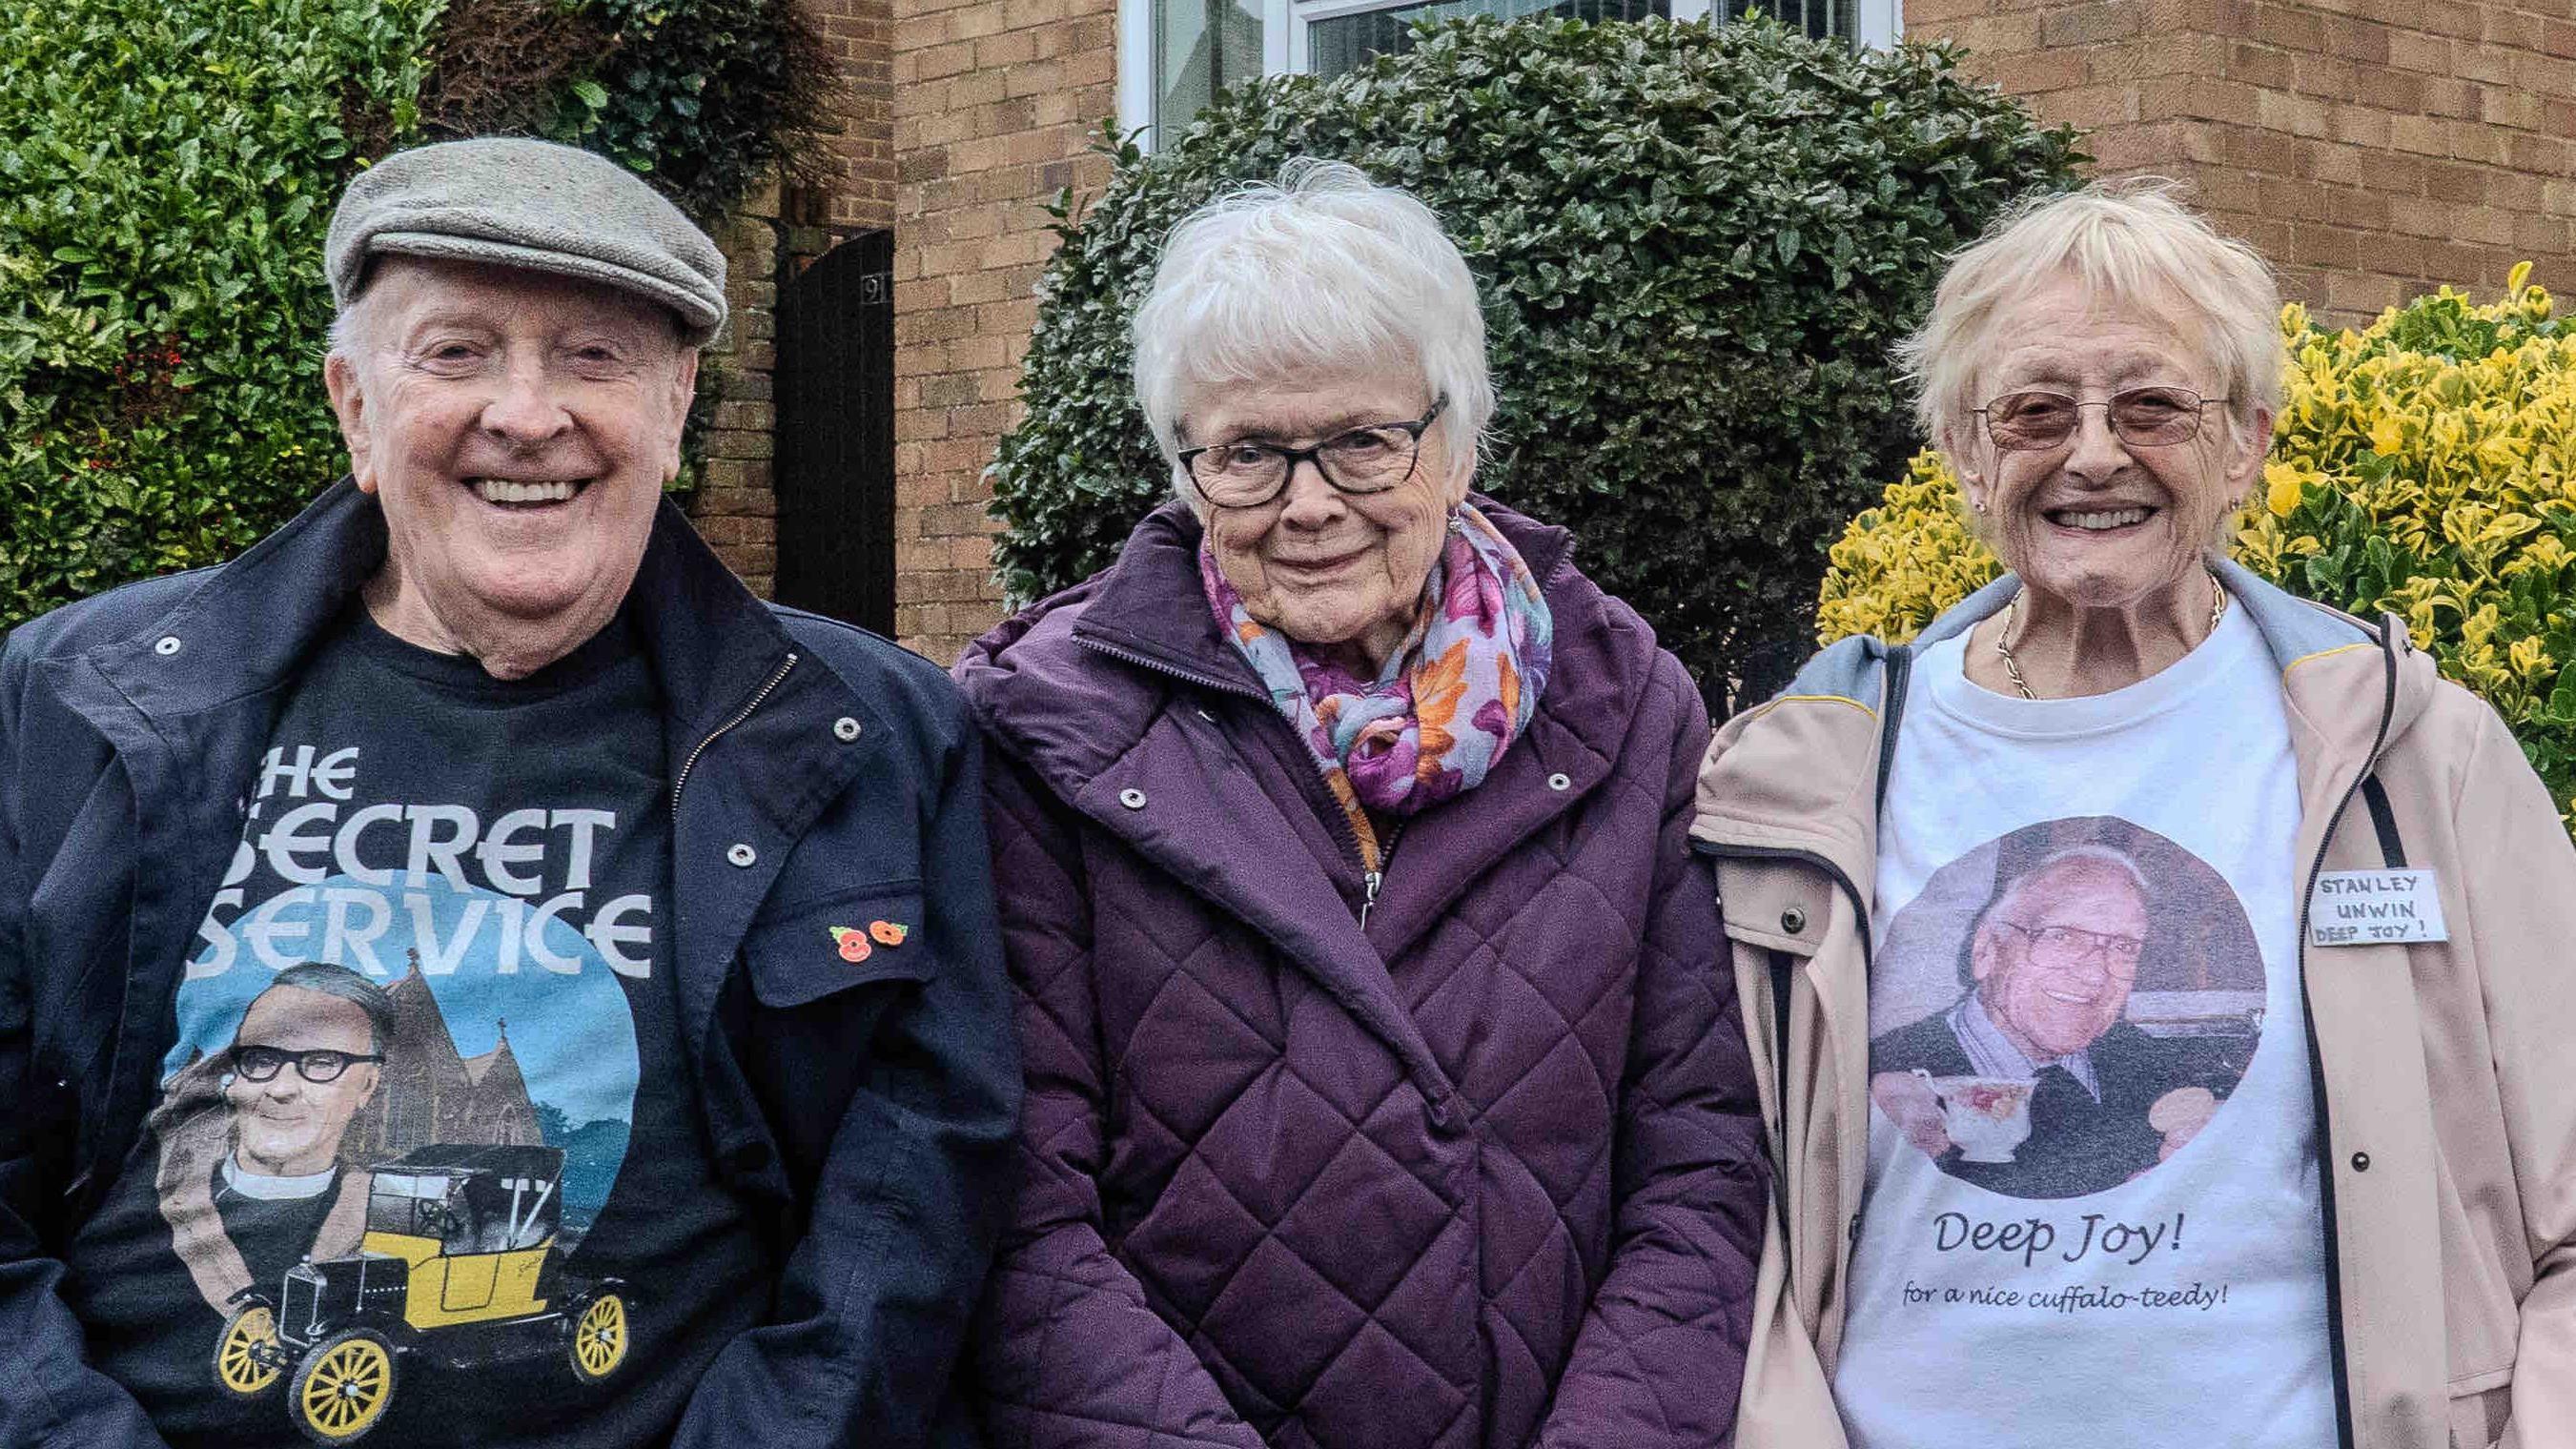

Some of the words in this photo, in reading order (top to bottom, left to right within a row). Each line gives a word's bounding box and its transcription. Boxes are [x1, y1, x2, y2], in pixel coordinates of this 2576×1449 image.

[257, 745, 359, 800] HE
[2320, 875, 2418, 894] STANLEY
[2337, 900, 2416, 919] UNWIN
[186, 887, 652, 979] SERVICE
[2315, 926, 2359, 942] DEEP
[1933, 1212, 2055, 1267] Deep
[2062, 1213, 2184, 1265] Joy!
[1902, 1280, 1937, 1307] for
[1945, 1288, 1966, 1303] a
[1969, 1285, 2023, 1307] nice
[2028, 1282, 2228, 1313] cuffalo-teedy!
